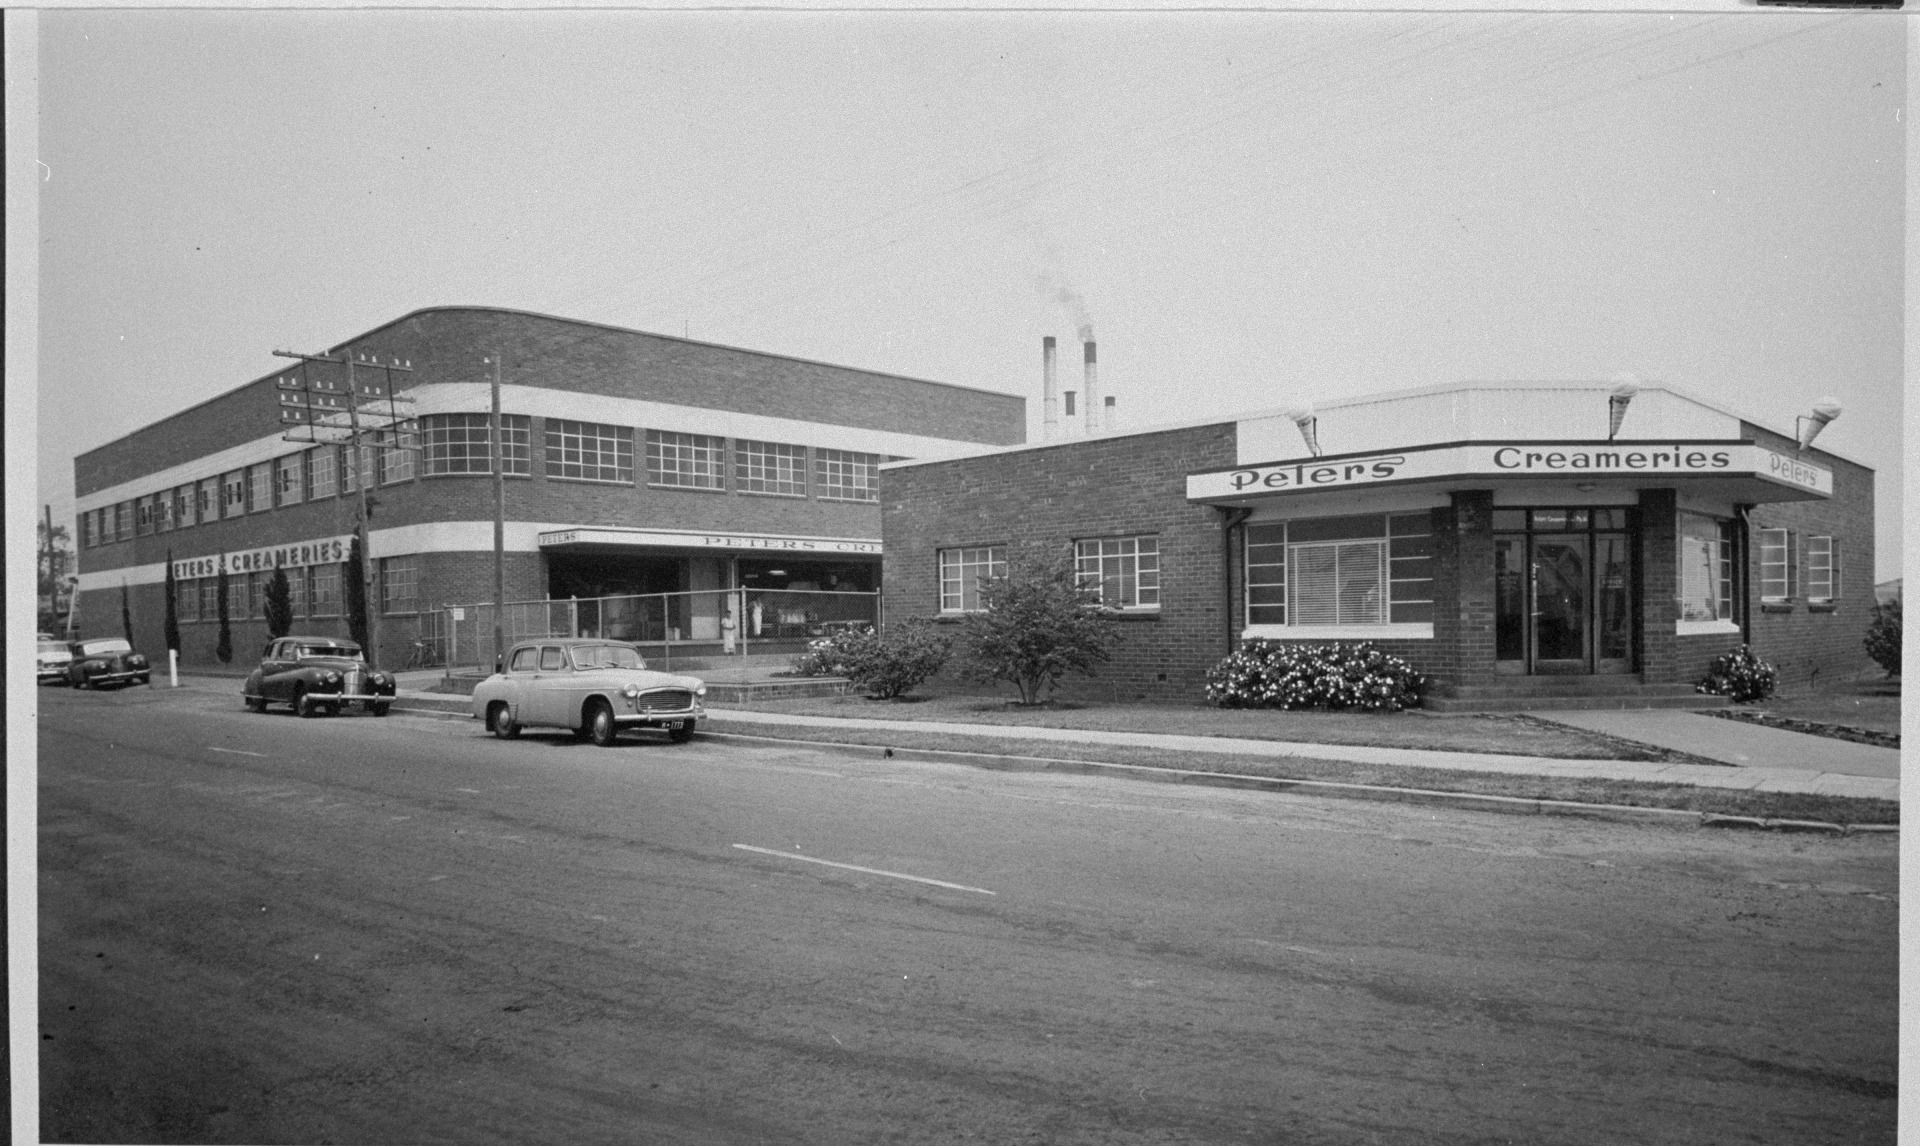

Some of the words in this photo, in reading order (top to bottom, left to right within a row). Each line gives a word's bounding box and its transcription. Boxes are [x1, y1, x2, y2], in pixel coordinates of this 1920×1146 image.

[1230, 456, 1405, 490] Peters
[1494, 446, 1730, 468] Creameries
[1770, 453, 1818, 486] Peters
[542, 532, 576, 544] PETERS
[705, 537, 815, 550] PETERS
[174, 558, 214, 579] ETERS
[231, 540, 342, 572] CREAMERIES
